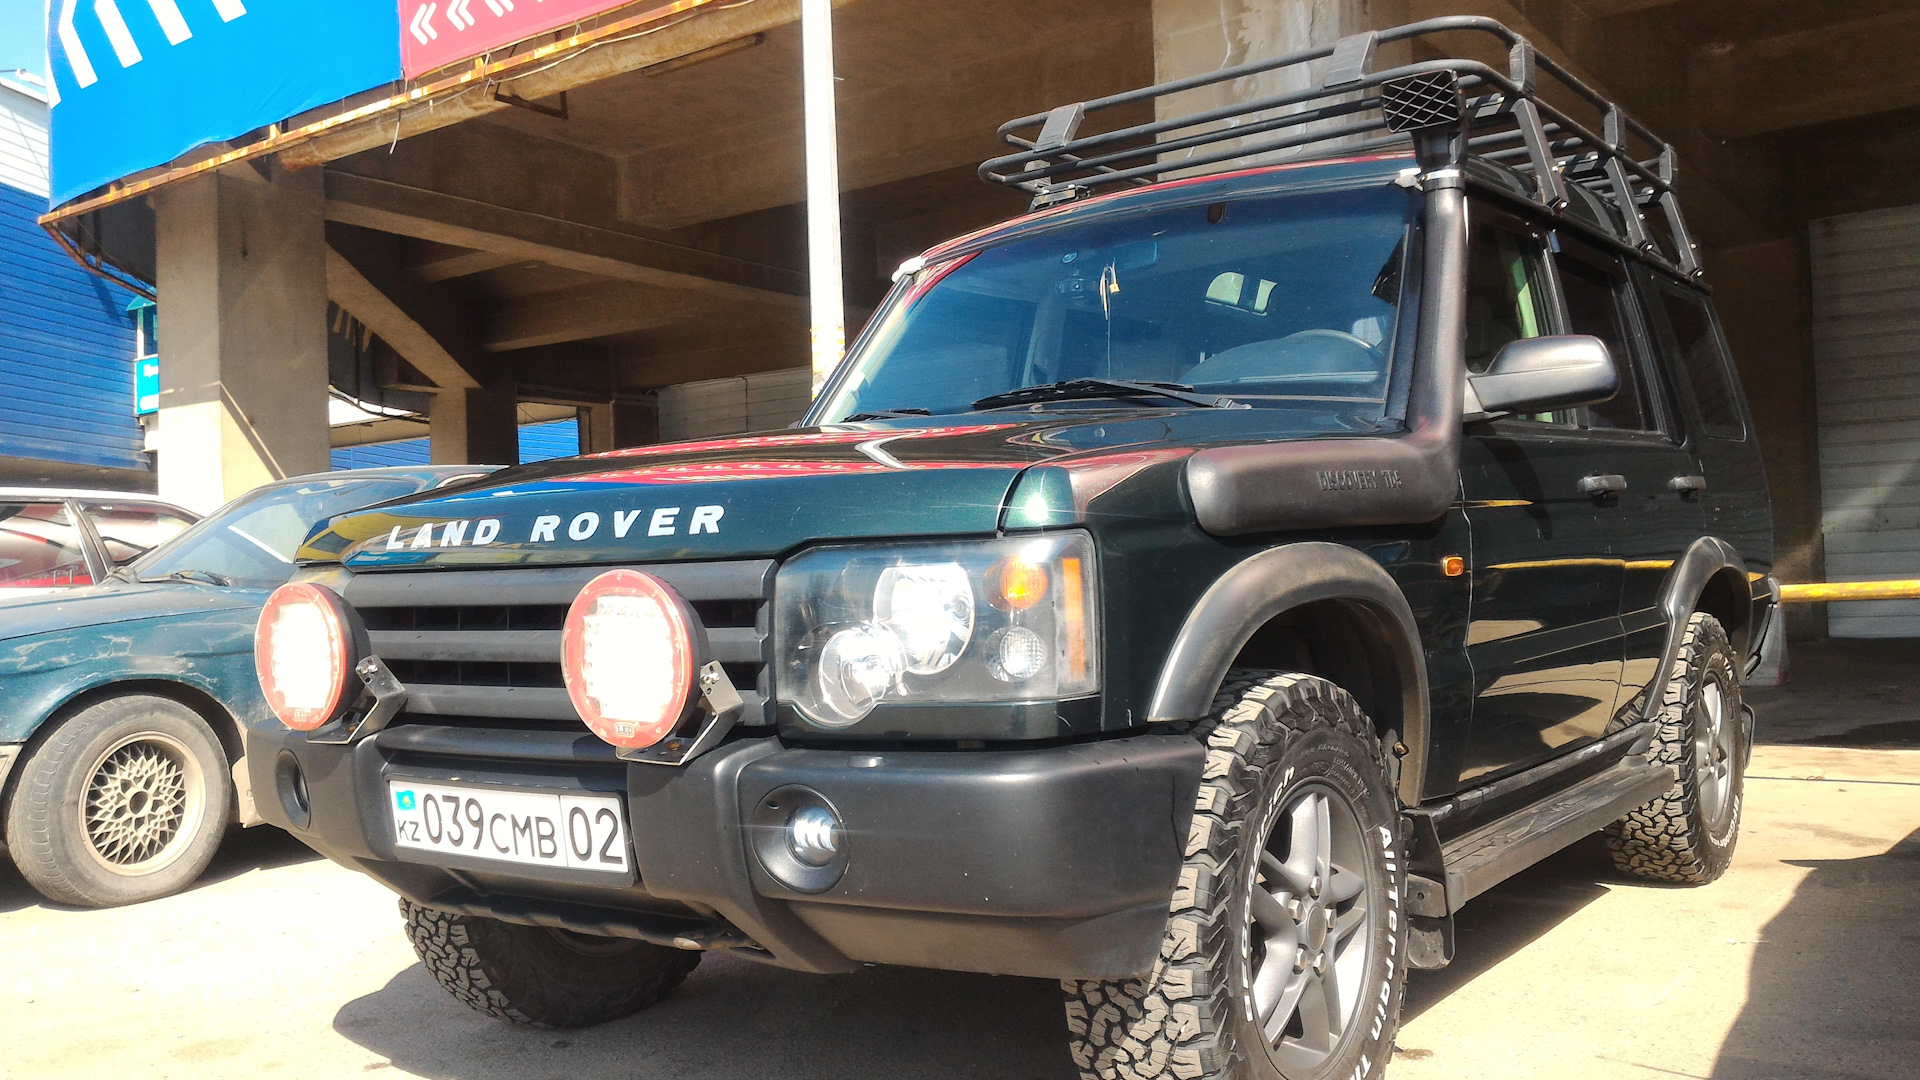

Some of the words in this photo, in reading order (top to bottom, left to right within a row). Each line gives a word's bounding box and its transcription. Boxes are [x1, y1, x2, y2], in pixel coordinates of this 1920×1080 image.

[1316, 469, 1378, 491] DISCOVERY
[386, 518, 501, 551] LAND
[529, 505, 725, 543] ROVER
[617, 725, 633, 735] LED
[397, 820, 421, 842] KZ
[568, 806, 623, 865] 02
[1371, 825, 1399, 1041] All-Terrain
